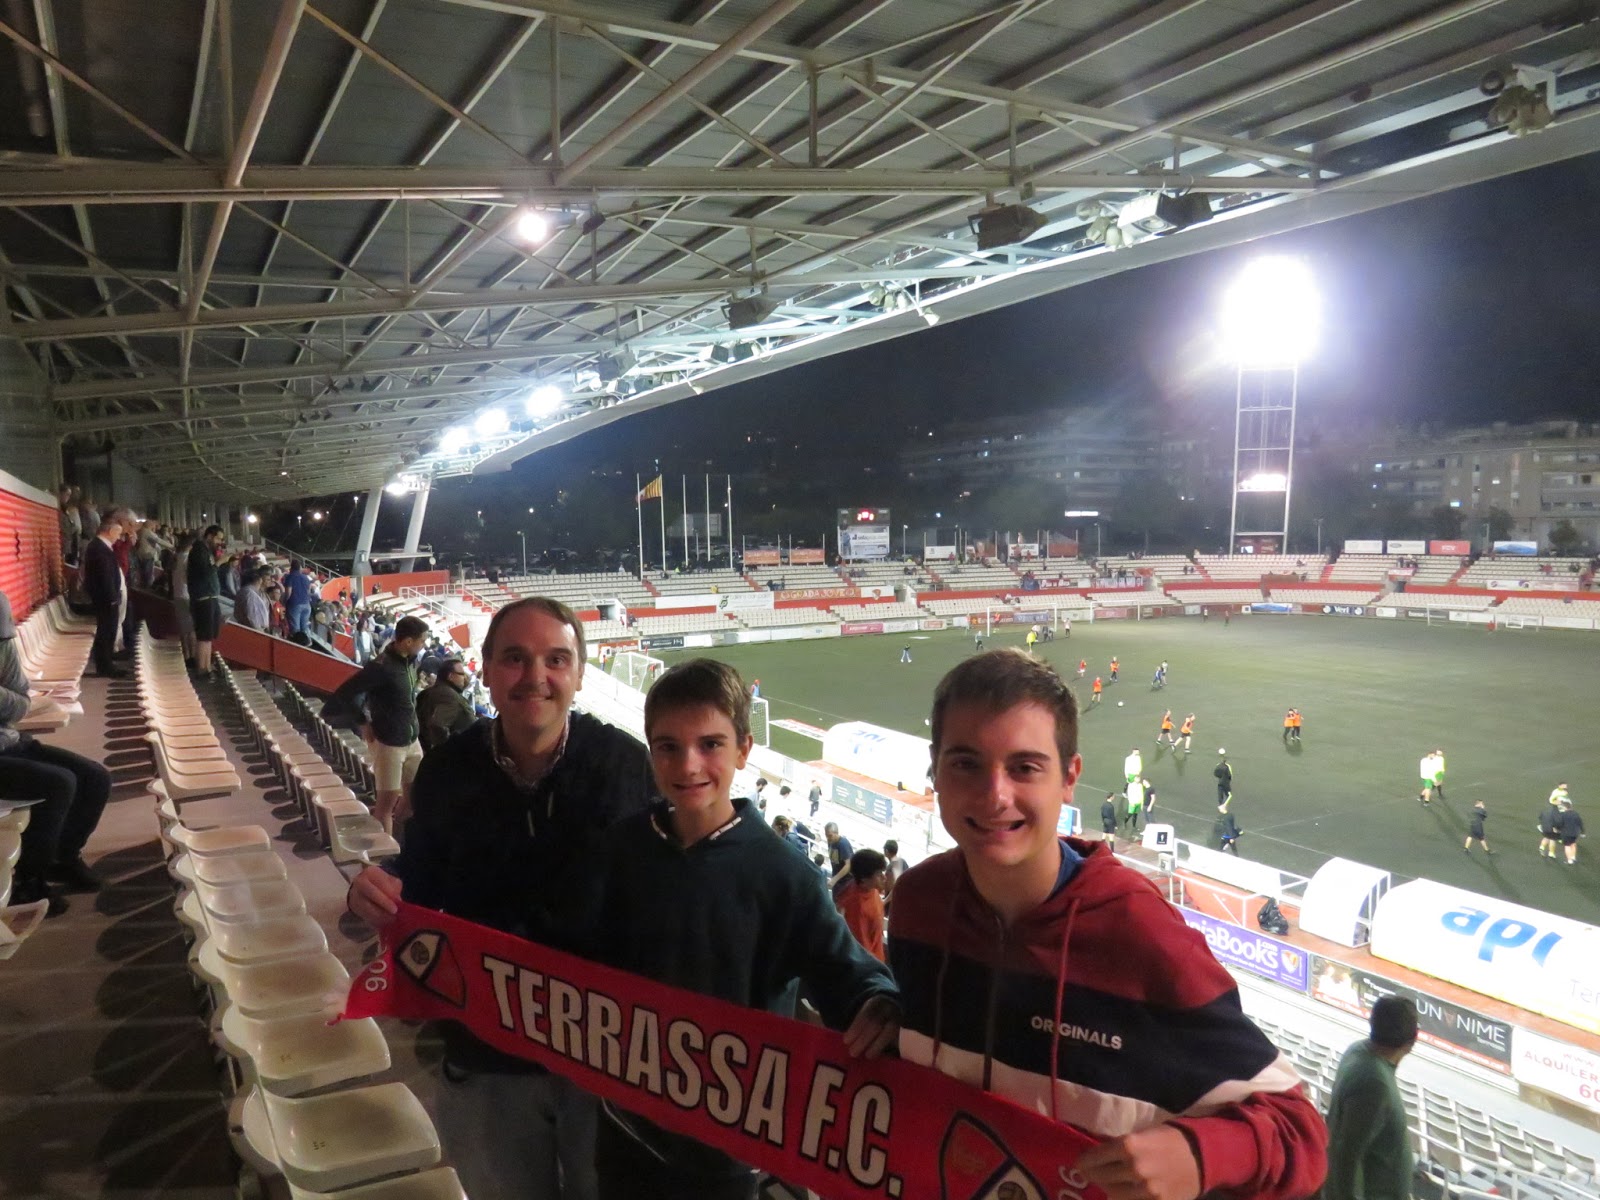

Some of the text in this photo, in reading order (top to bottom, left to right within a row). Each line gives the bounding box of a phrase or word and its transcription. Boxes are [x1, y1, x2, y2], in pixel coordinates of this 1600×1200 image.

[482, 953, 904, 1198] TERRASSA F.C.
[1030, 1015, 1123, 1051] ORGINALS
